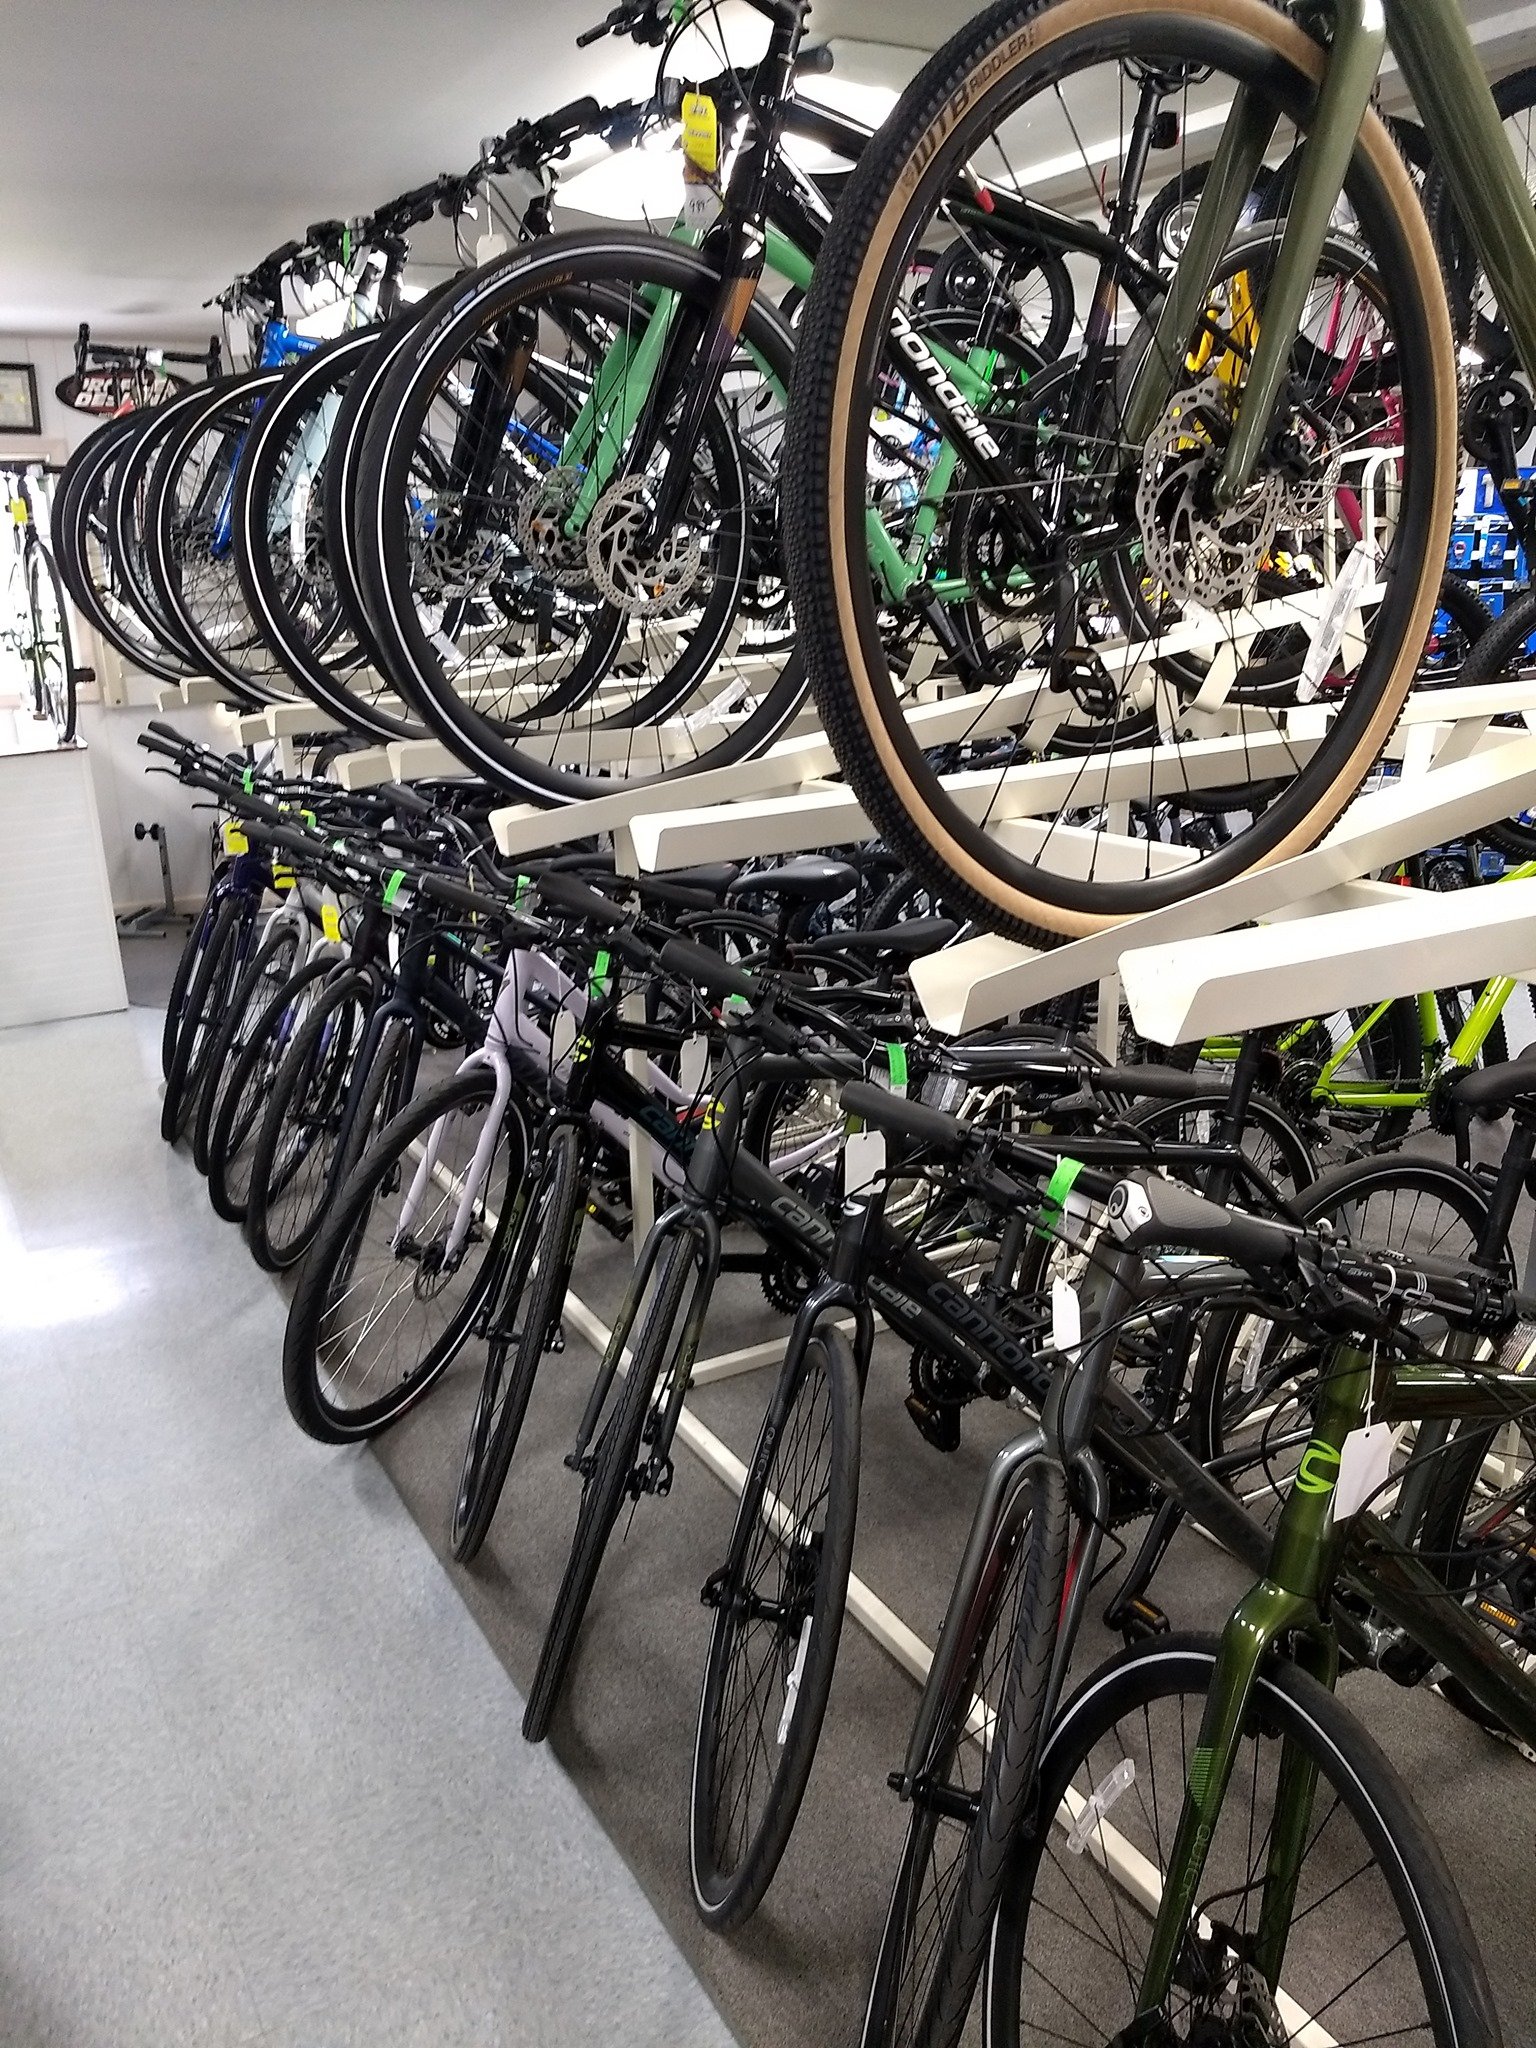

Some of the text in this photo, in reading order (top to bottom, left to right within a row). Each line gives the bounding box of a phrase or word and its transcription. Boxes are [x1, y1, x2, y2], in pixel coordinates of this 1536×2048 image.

[968, 33, 1029, 94] RIDDLER
[754, 1426, 776, 1482] QUICK
[1178, 1823, 1211, 1899] QUICK
